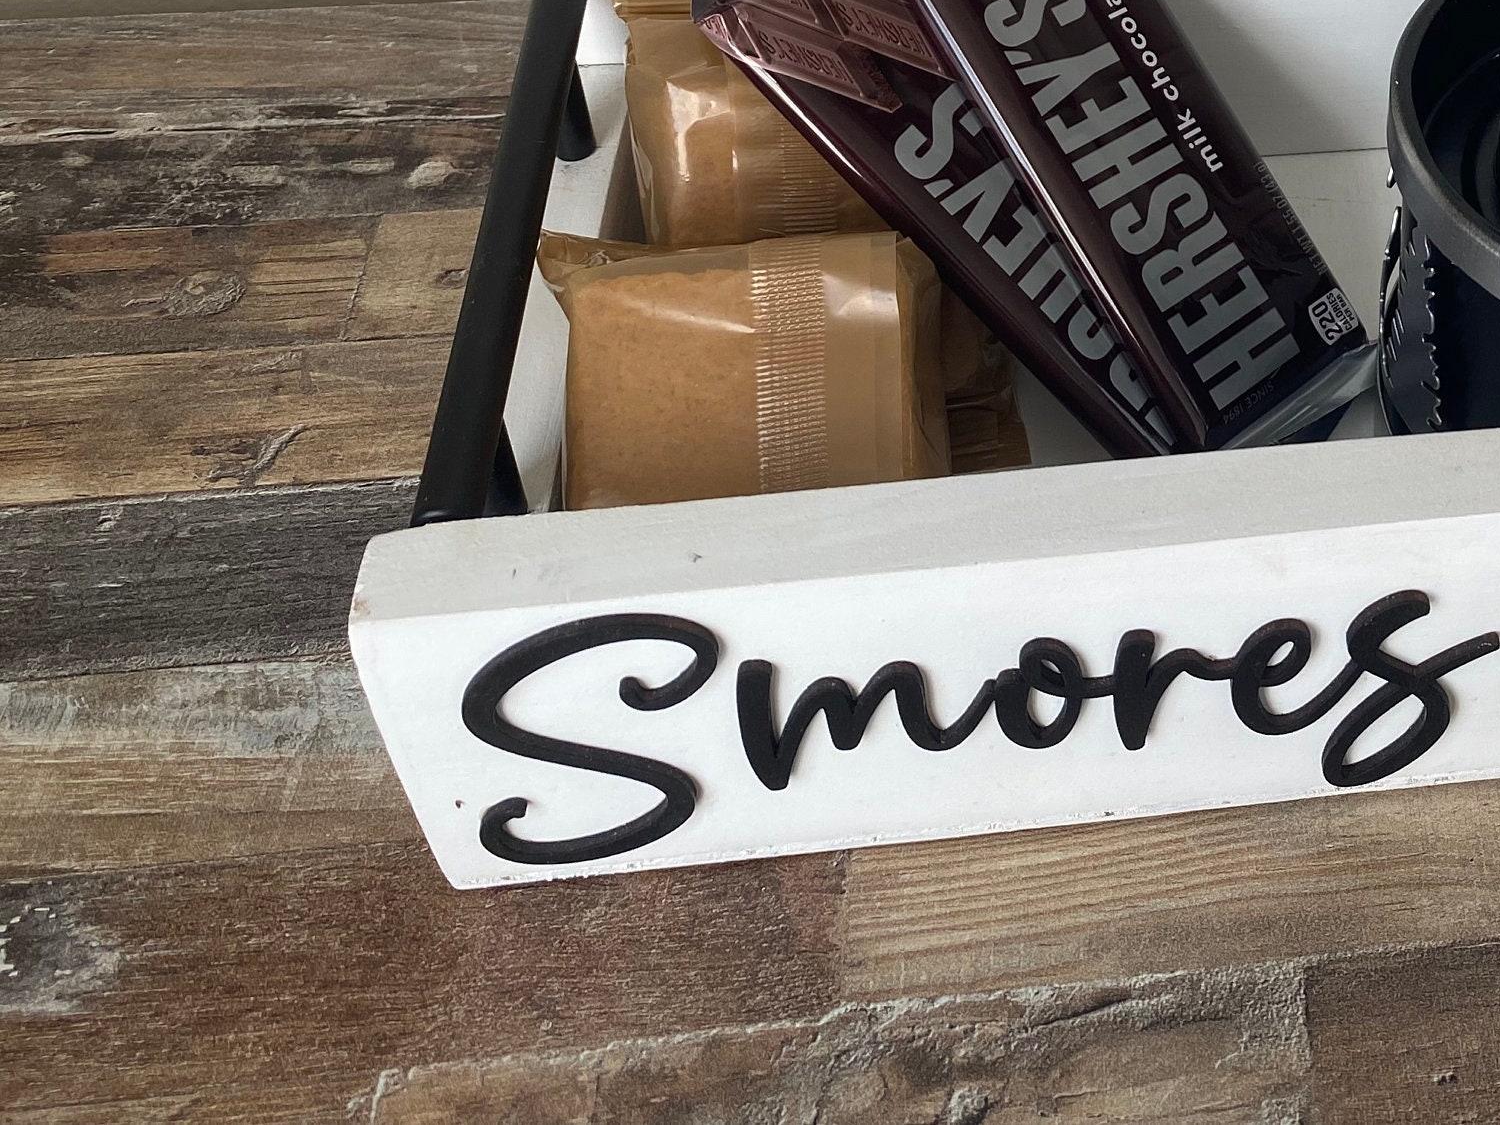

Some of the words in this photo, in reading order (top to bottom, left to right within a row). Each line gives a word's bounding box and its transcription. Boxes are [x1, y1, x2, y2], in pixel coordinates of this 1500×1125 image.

[1176, 108, 1224, 173] milk
[1297, 234, 1313, 254] WT
[894, 81, 1176, 446] HEY'S
[1309, 254, 1329, 276] NET
[1326, 292, 1353, 331] CALORIES
[1336, 293, 1347, 308] BAR
[1344, 307, 1355, 322] PER
[1312, 301, 1344, 341] 220
[1244, 379, 1275, 409] SINCE
[1222, 402, 1244, 425] 1894
[461, 588, 1500, 865] Smores
